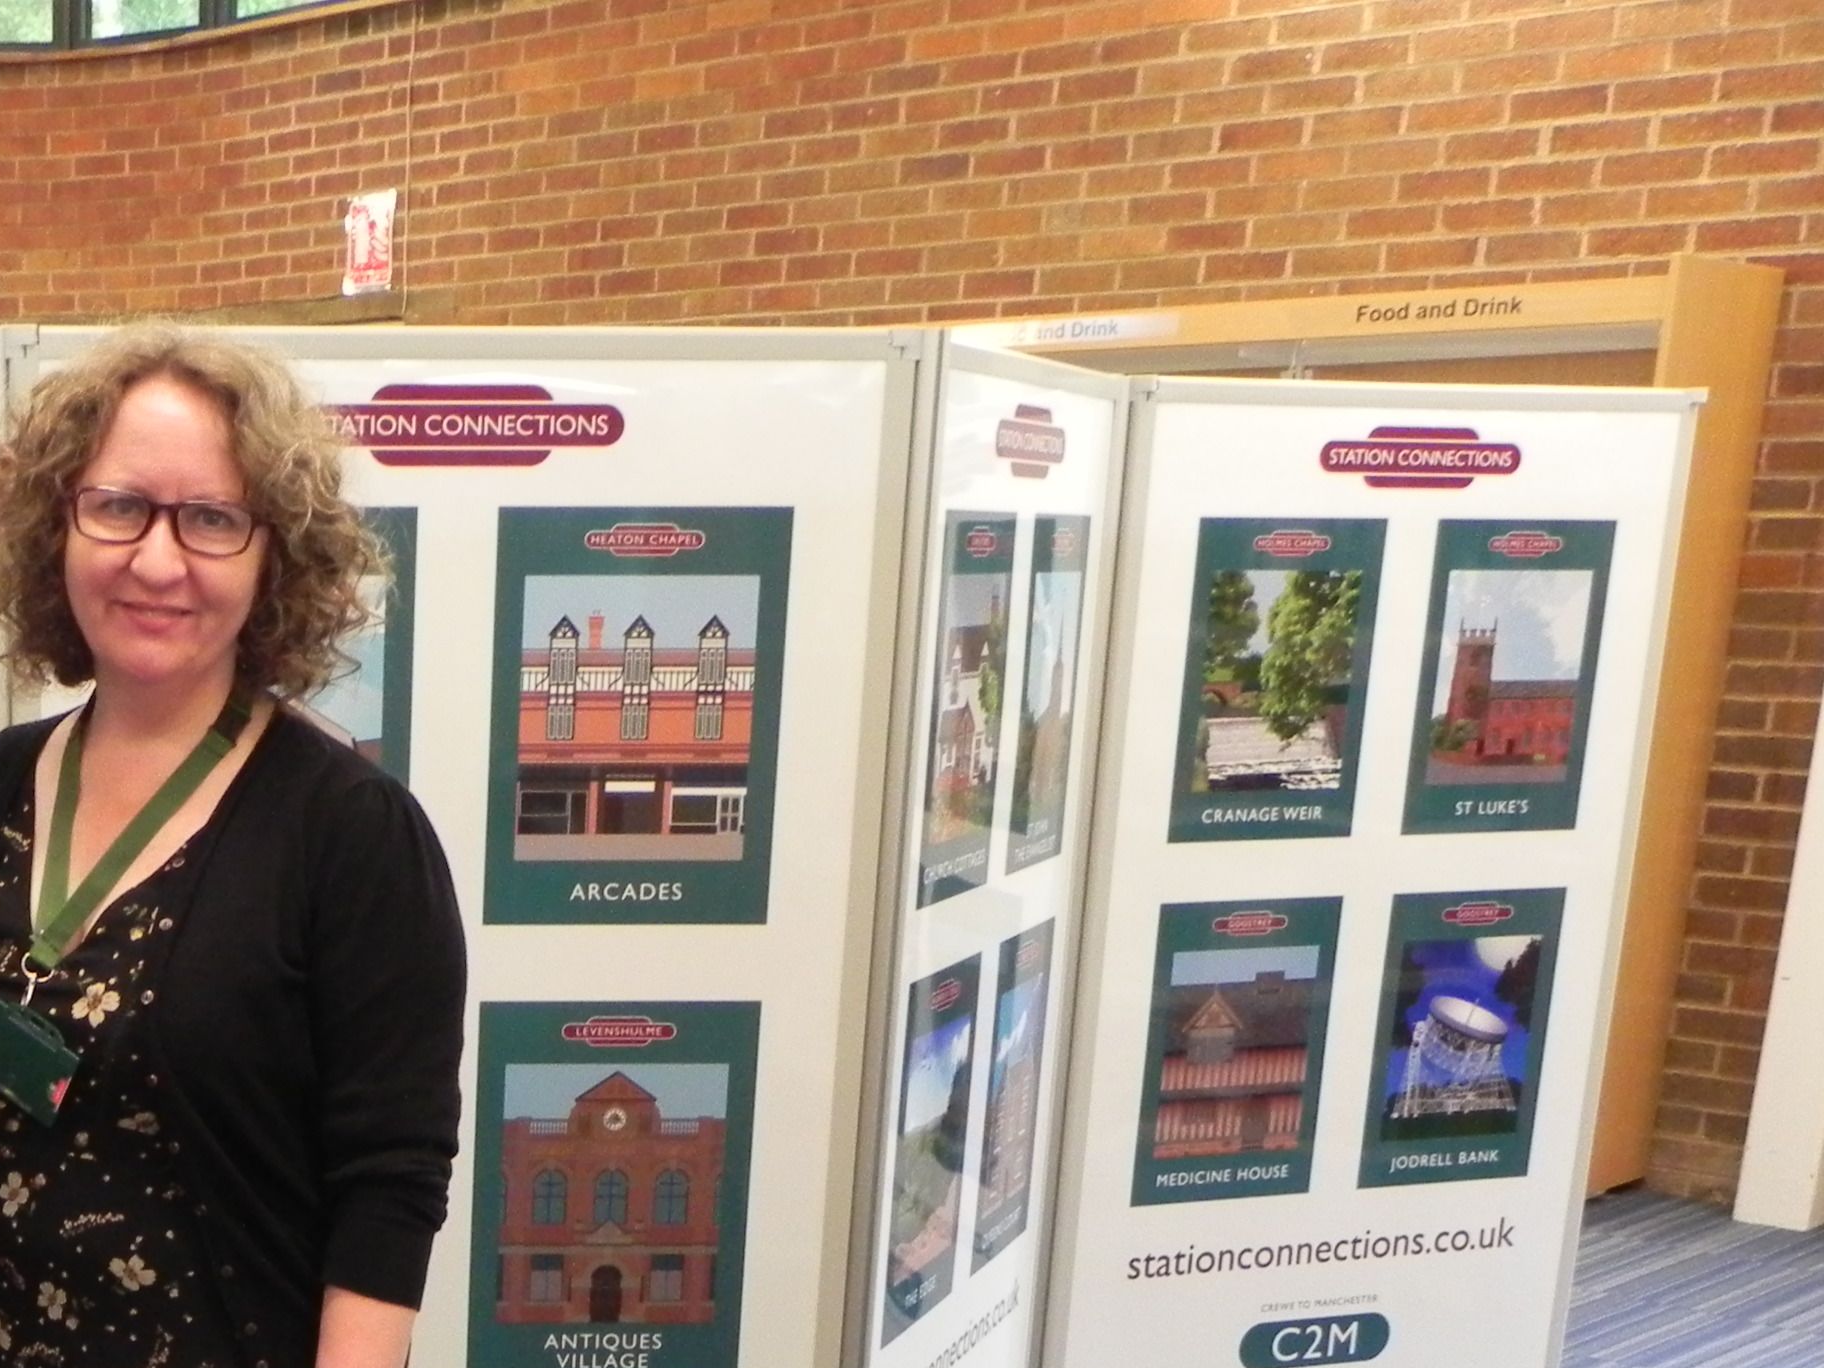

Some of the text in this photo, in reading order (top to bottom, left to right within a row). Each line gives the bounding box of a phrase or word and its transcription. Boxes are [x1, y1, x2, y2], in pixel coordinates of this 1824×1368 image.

[1356, 295, 1523, 324] Food and Drink
[1071, 320, 1119, 338] Drink
[323, 413, 609, 438] TATION CONNECTIONS
[1328, 446, 1514, 469] STATION CONNECTIONS
[589, 533, 701, 546] HEATON CHAPEL
[1202, 805, 1323, 825] CRANAGE WEIR
[1455, 799, 1530, 816] ST LUKE'S
[569, 882, 683, 902] ARCADES
[574, 1026, 664, 1038] LEVENSHULME
[1389, 1148, 1501, 1174] JODRELL BANK
[1155, 1163, 1290, 1188] MEDICINE HOUSE
[1127, 1217, 1516, 1281] stationconnections.co.uk
[1260, 1293, 1379, 1313] CREWE TO MANCHESTER
[544, 1332, 663, 1352] ANTIQUES
[1272, 1321, 1359, 1362] C2M
